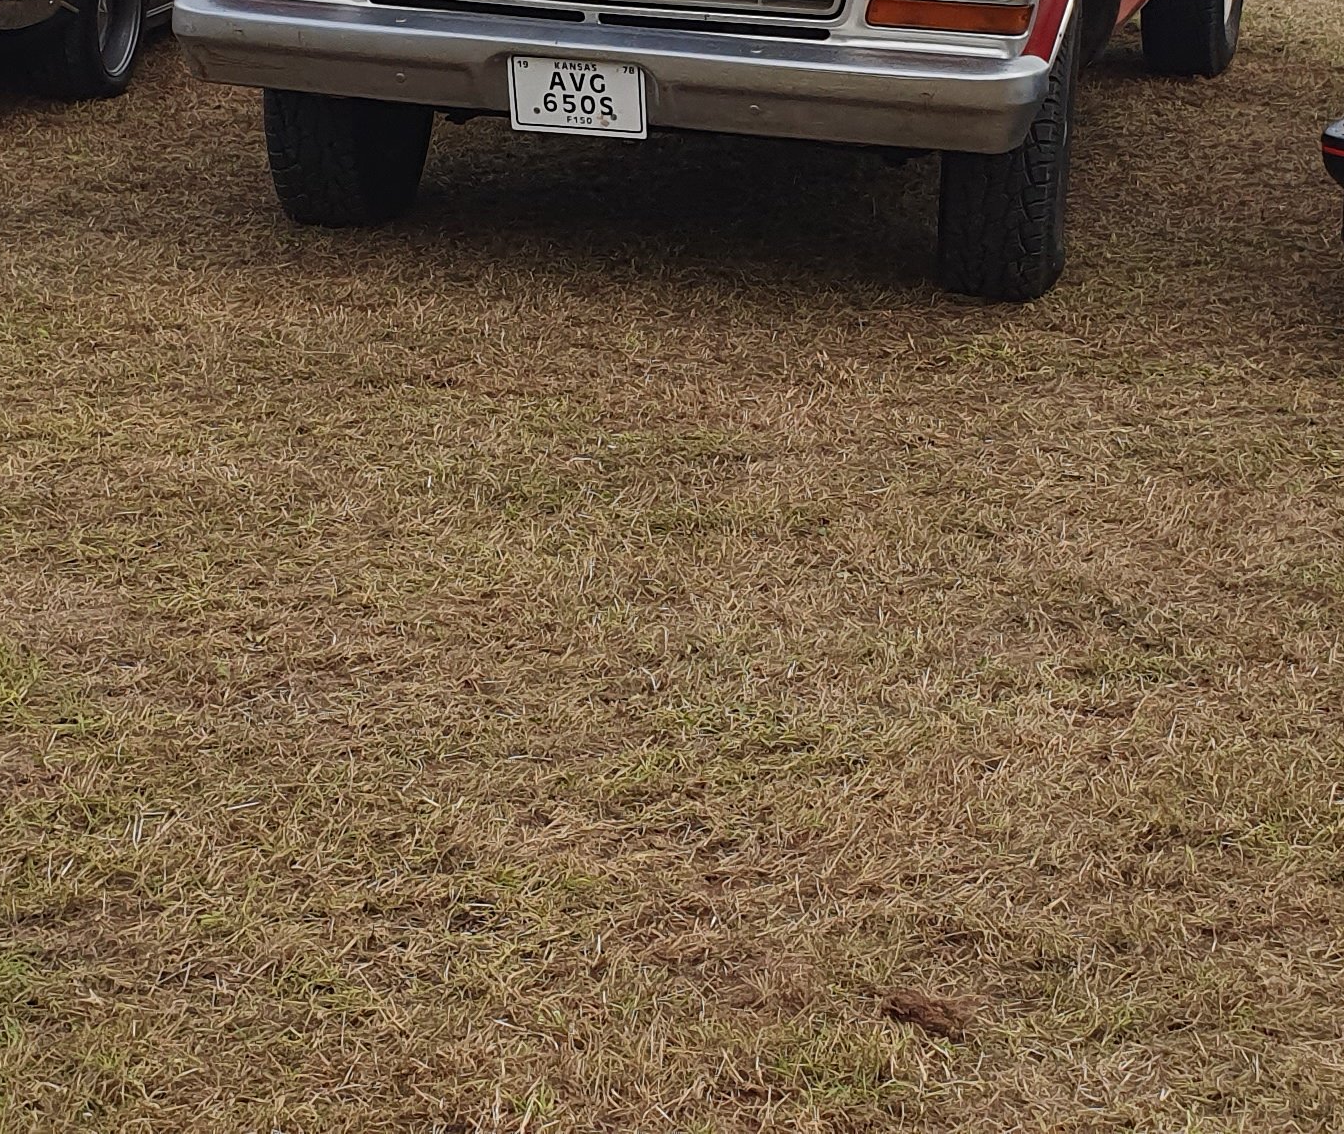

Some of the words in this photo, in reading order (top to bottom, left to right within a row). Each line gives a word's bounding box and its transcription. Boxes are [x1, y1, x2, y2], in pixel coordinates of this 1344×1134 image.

[516, 60, 529, 69] 19
[554, 61, 597, 72] KANSAS
[622, 66, 635, 75] 78
[549, 71, 606, 94] AVG
[543, 92, 614, 116] 650S
[566, 115, 593, 125] F150
